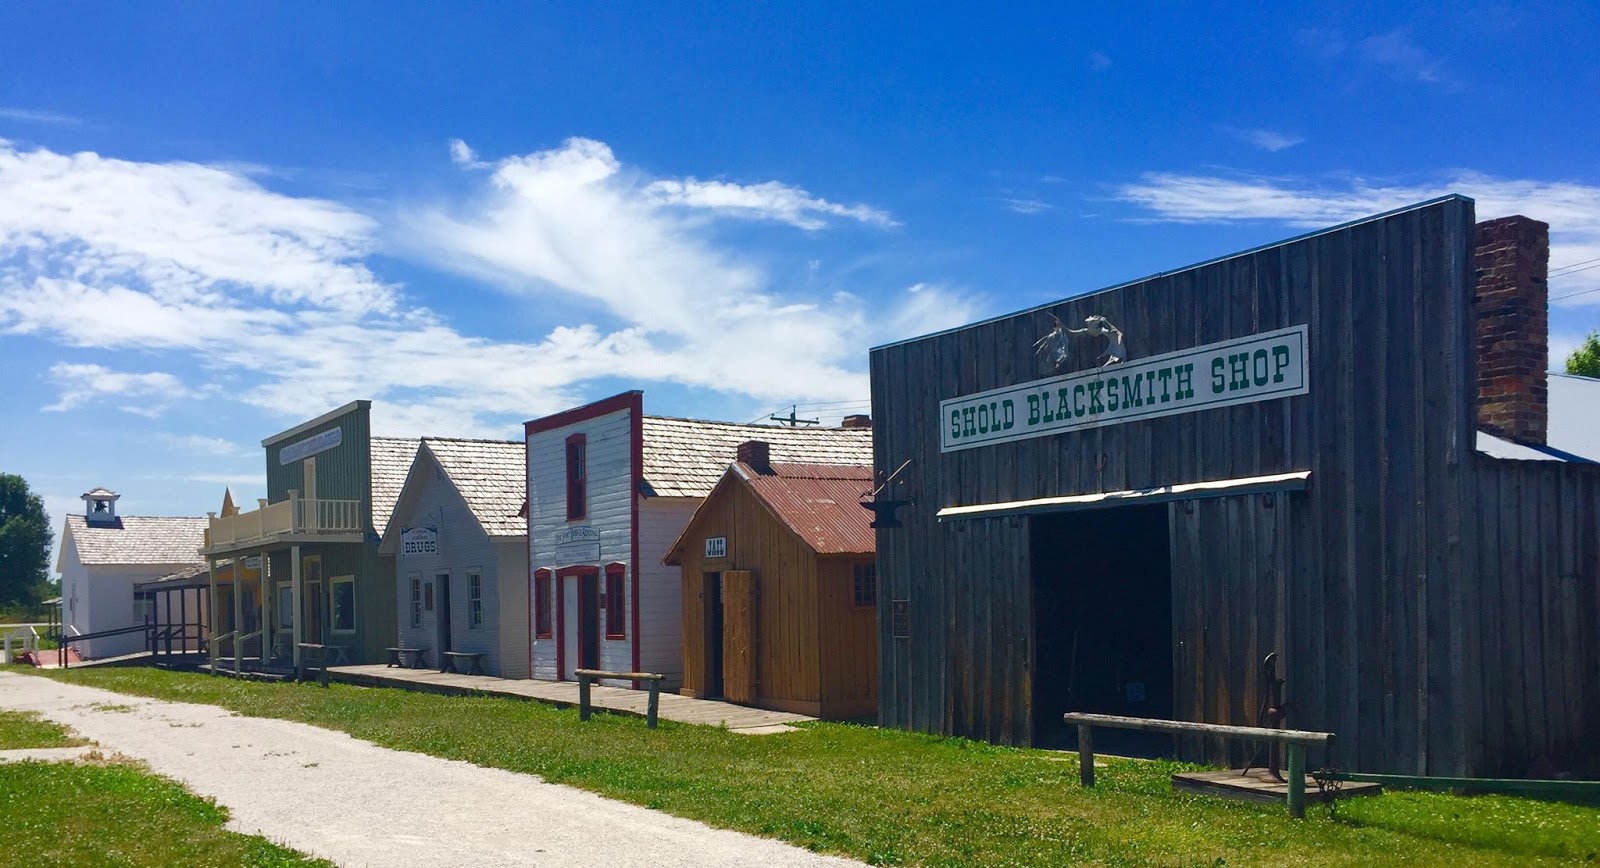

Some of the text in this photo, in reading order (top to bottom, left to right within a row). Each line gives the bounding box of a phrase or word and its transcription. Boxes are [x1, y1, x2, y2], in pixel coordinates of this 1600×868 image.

[951, 344, 1290, 439] SHOLD BLACKSMITH SHOP
[405, 541, 436, 553] DRUGS
[707, 539, 724, 556] JAIL
